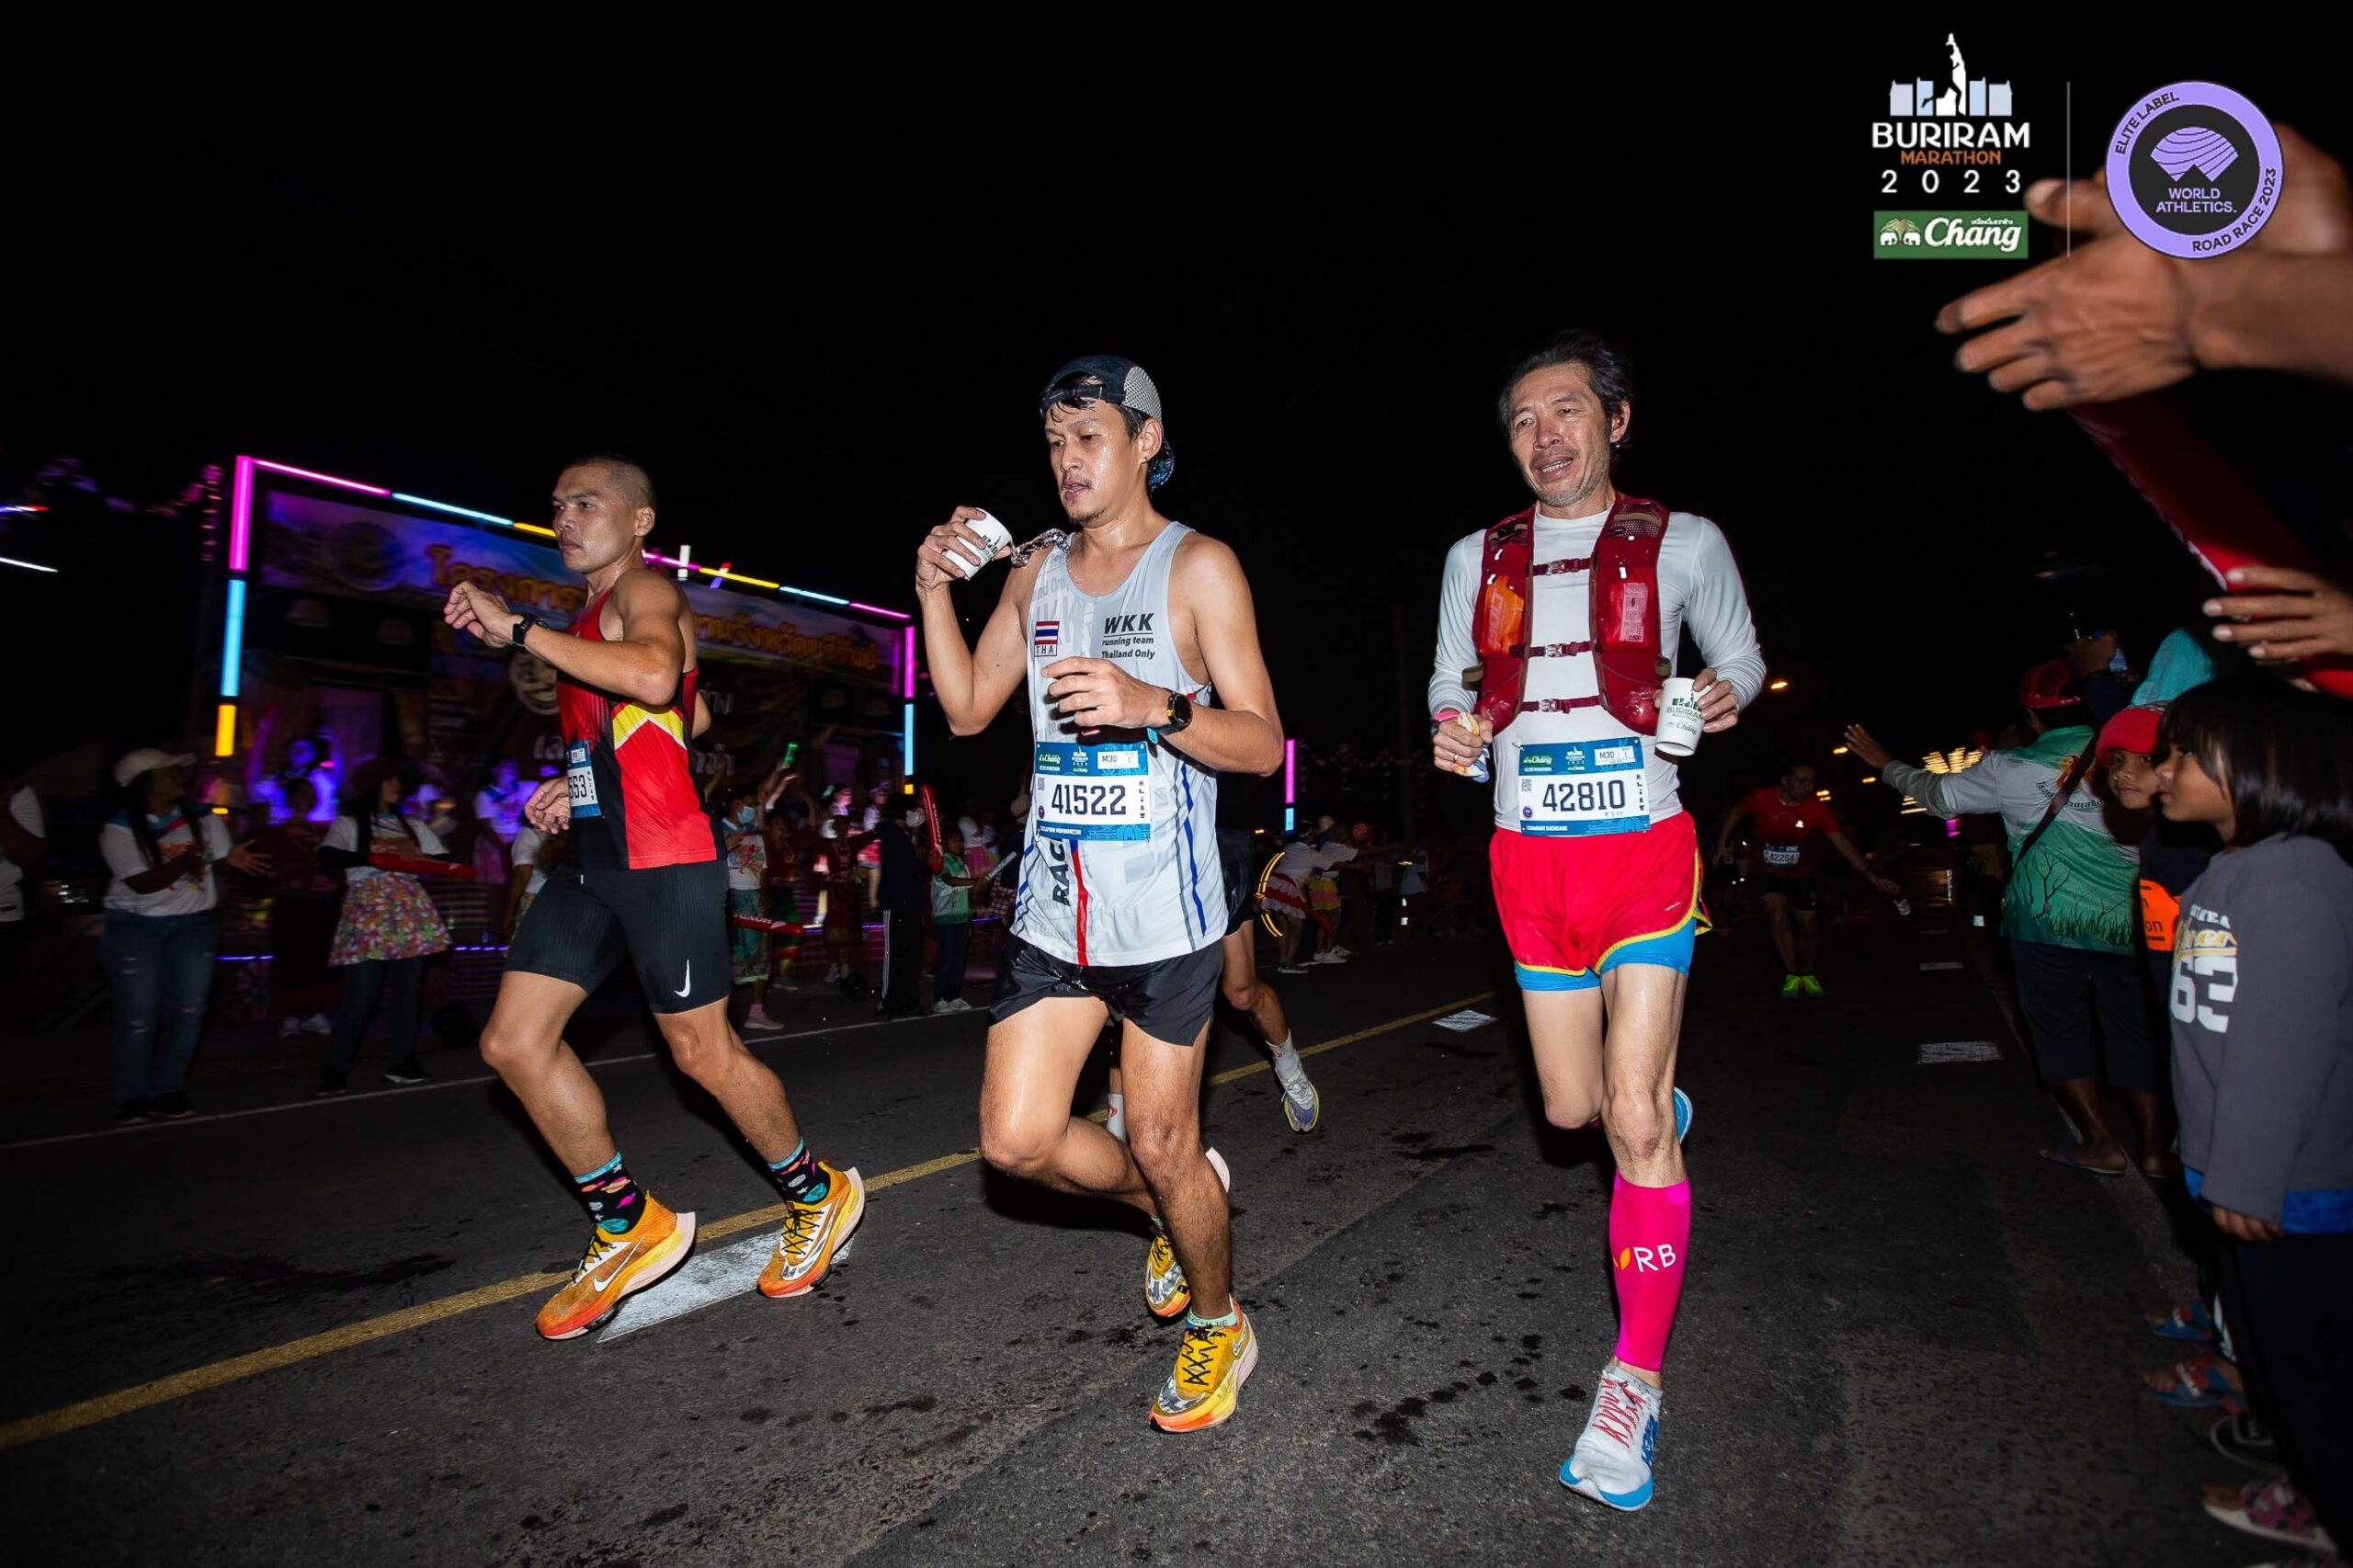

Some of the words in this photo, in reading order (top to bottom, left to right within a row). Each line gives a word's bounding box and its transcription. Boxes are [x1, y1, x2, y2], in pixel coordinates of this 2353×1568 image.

[1104, 613, 1155, 634] WKK
[1035, 644, 1056, 656] THA
[1101, 637, 1132, 648] running
[1134, 635, 1154, 645] team
[1101, 650, 1133, 659] Thailand
[1134, 650, 1155, 661] Only
[1677, 722, 1698, 735] Chang
[1531, 756, 1552, 765] Chang
[1051, 784, 1127, 816] 41522
[1542, 779, 1626, 812] 42810
[1049, 838, 1071, 906] RAC
[1633, 1244, 1676, 1272] RB
